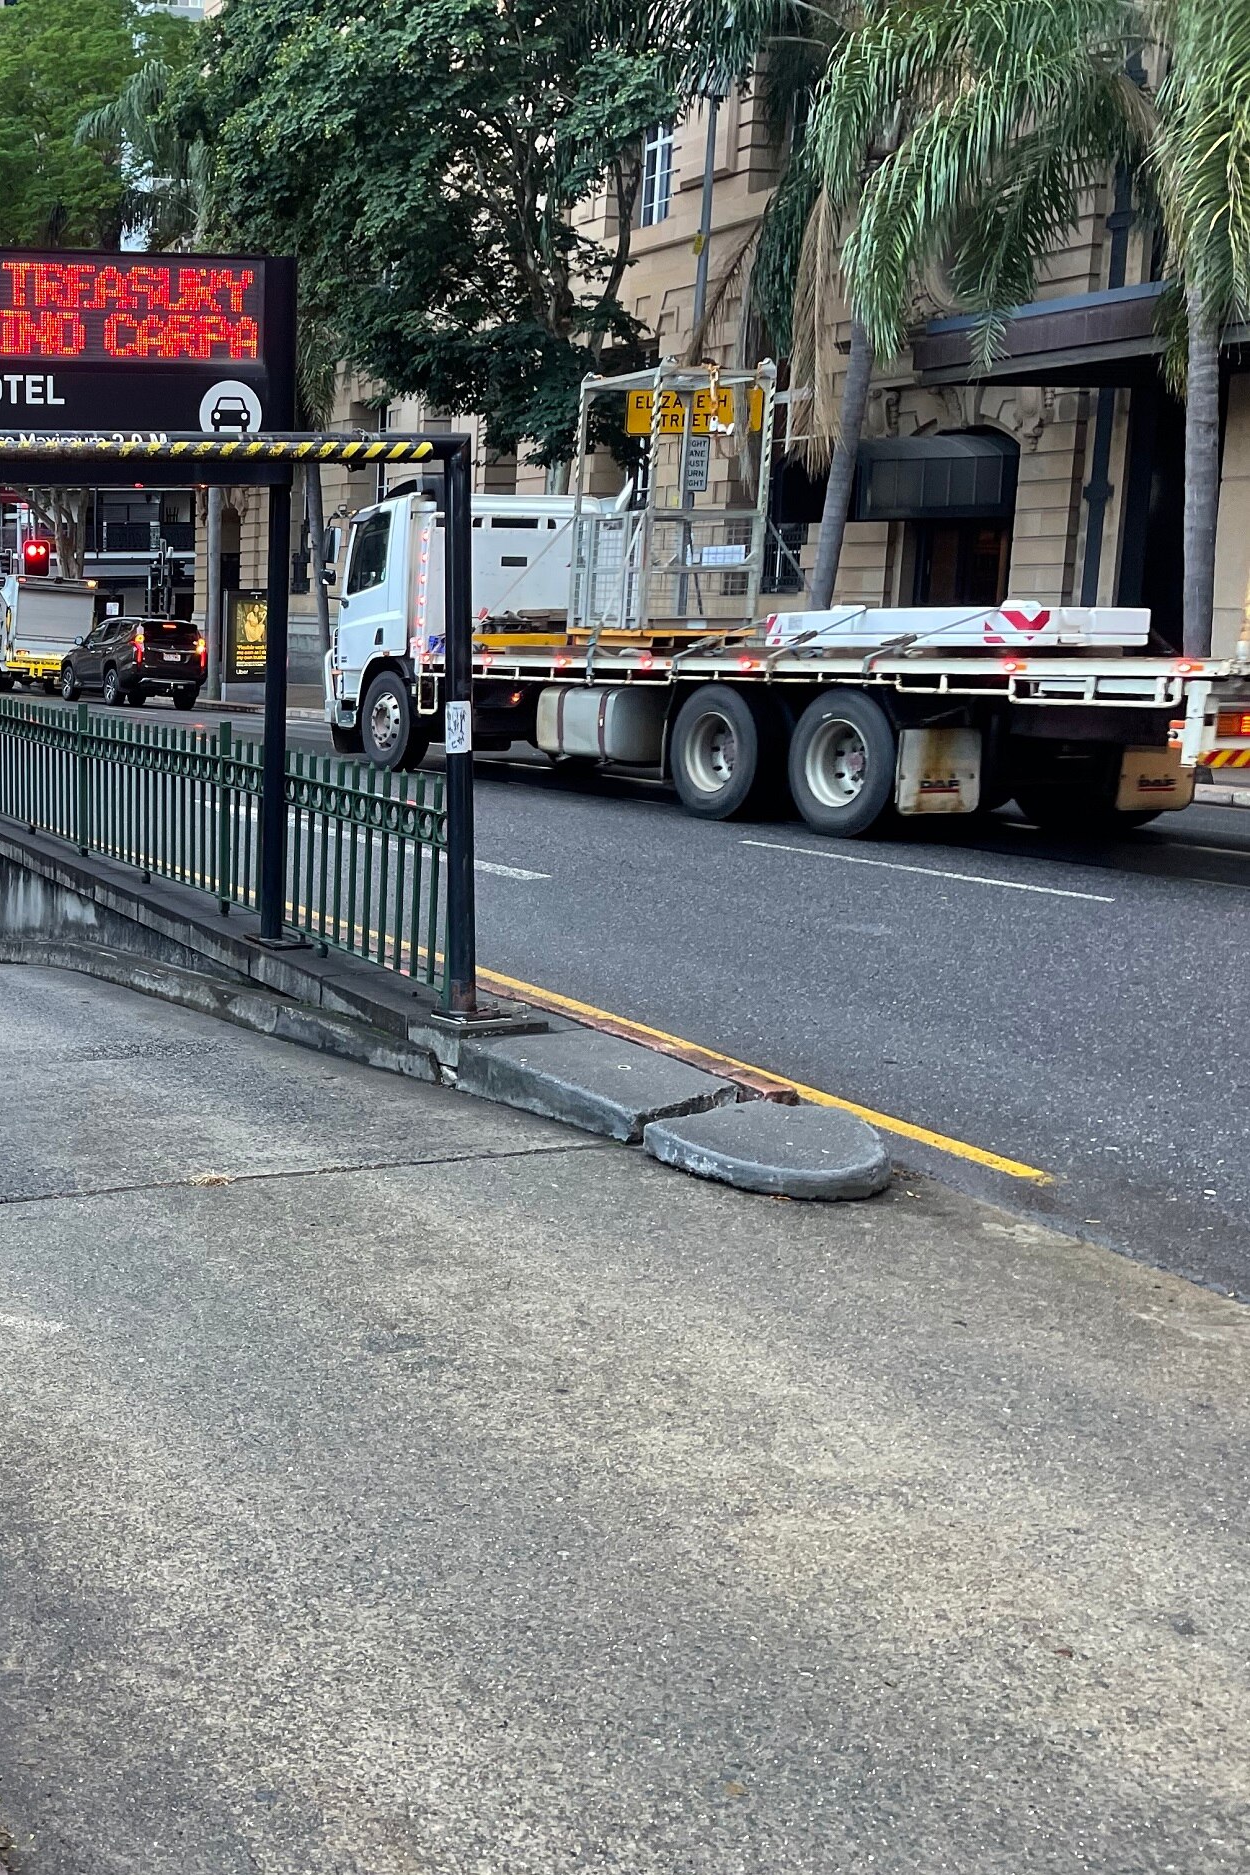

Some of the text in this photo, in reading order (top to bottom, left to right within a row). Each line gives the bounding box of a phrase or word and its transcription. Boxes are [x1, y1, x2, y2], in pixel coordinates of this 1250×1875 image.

[1, 261, 254, 312] TREASURY
[104, 313, 258, 359] CARPA
[636, 394, 727, 409] ELZAEH
[689, 450, 706, 458] ANE
